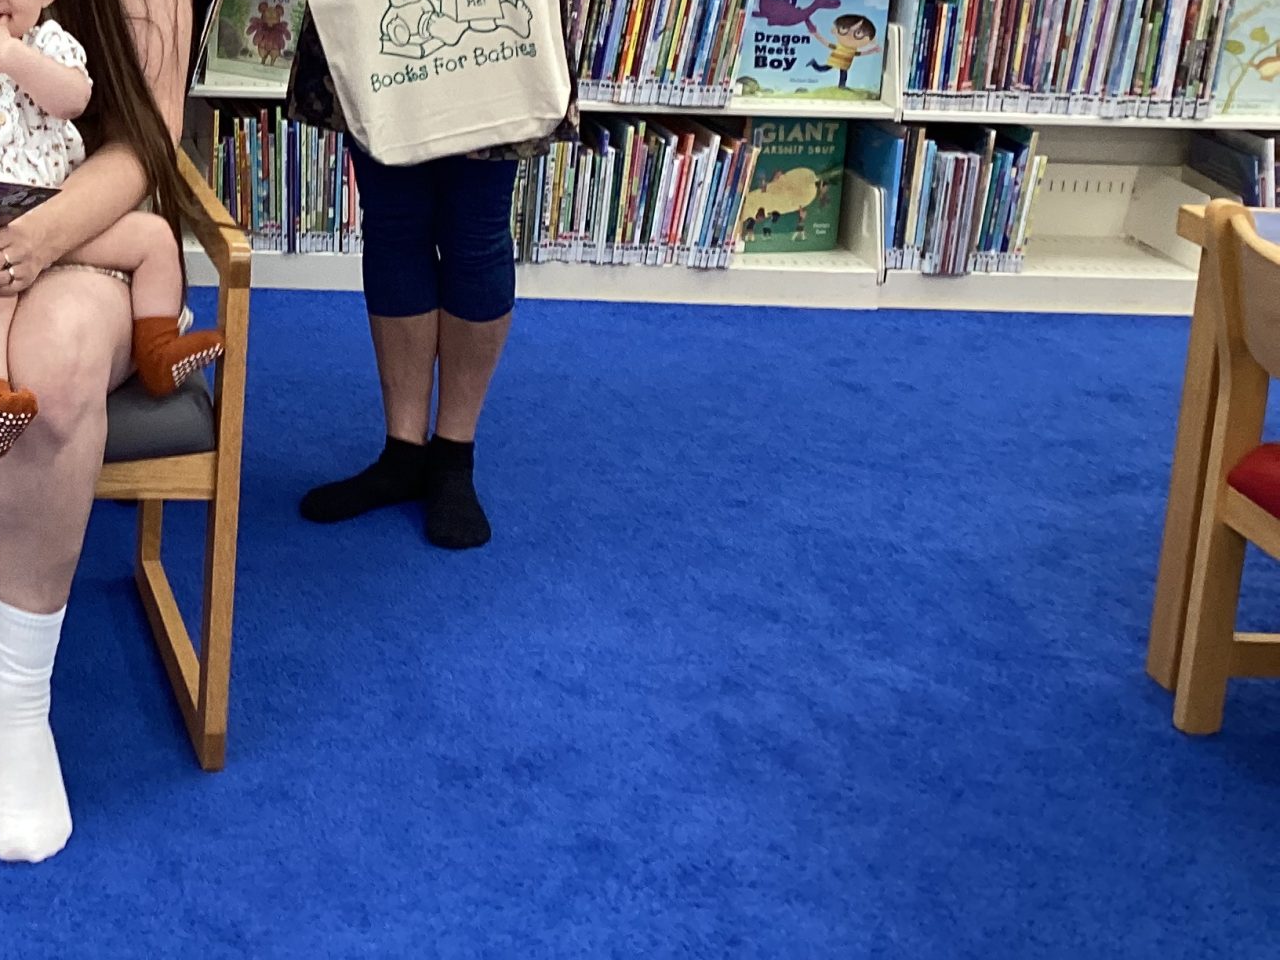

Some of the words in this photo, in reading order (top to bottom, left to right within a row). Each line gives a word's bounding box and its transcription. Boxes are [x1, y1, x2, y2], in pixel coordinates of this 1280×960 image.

[754, 31, 810, 46] Dragon
[755, 45, 796, 56] Meets
[371, 64, 428, 92] Books
[433, 54, 467, 75] For
[474, 41, 537, 66] Babies
[754, 55, 797, 71] Boy
[761, 122, 839, 143] GIANT
[763, 144, 802, 155] ARSNIP
